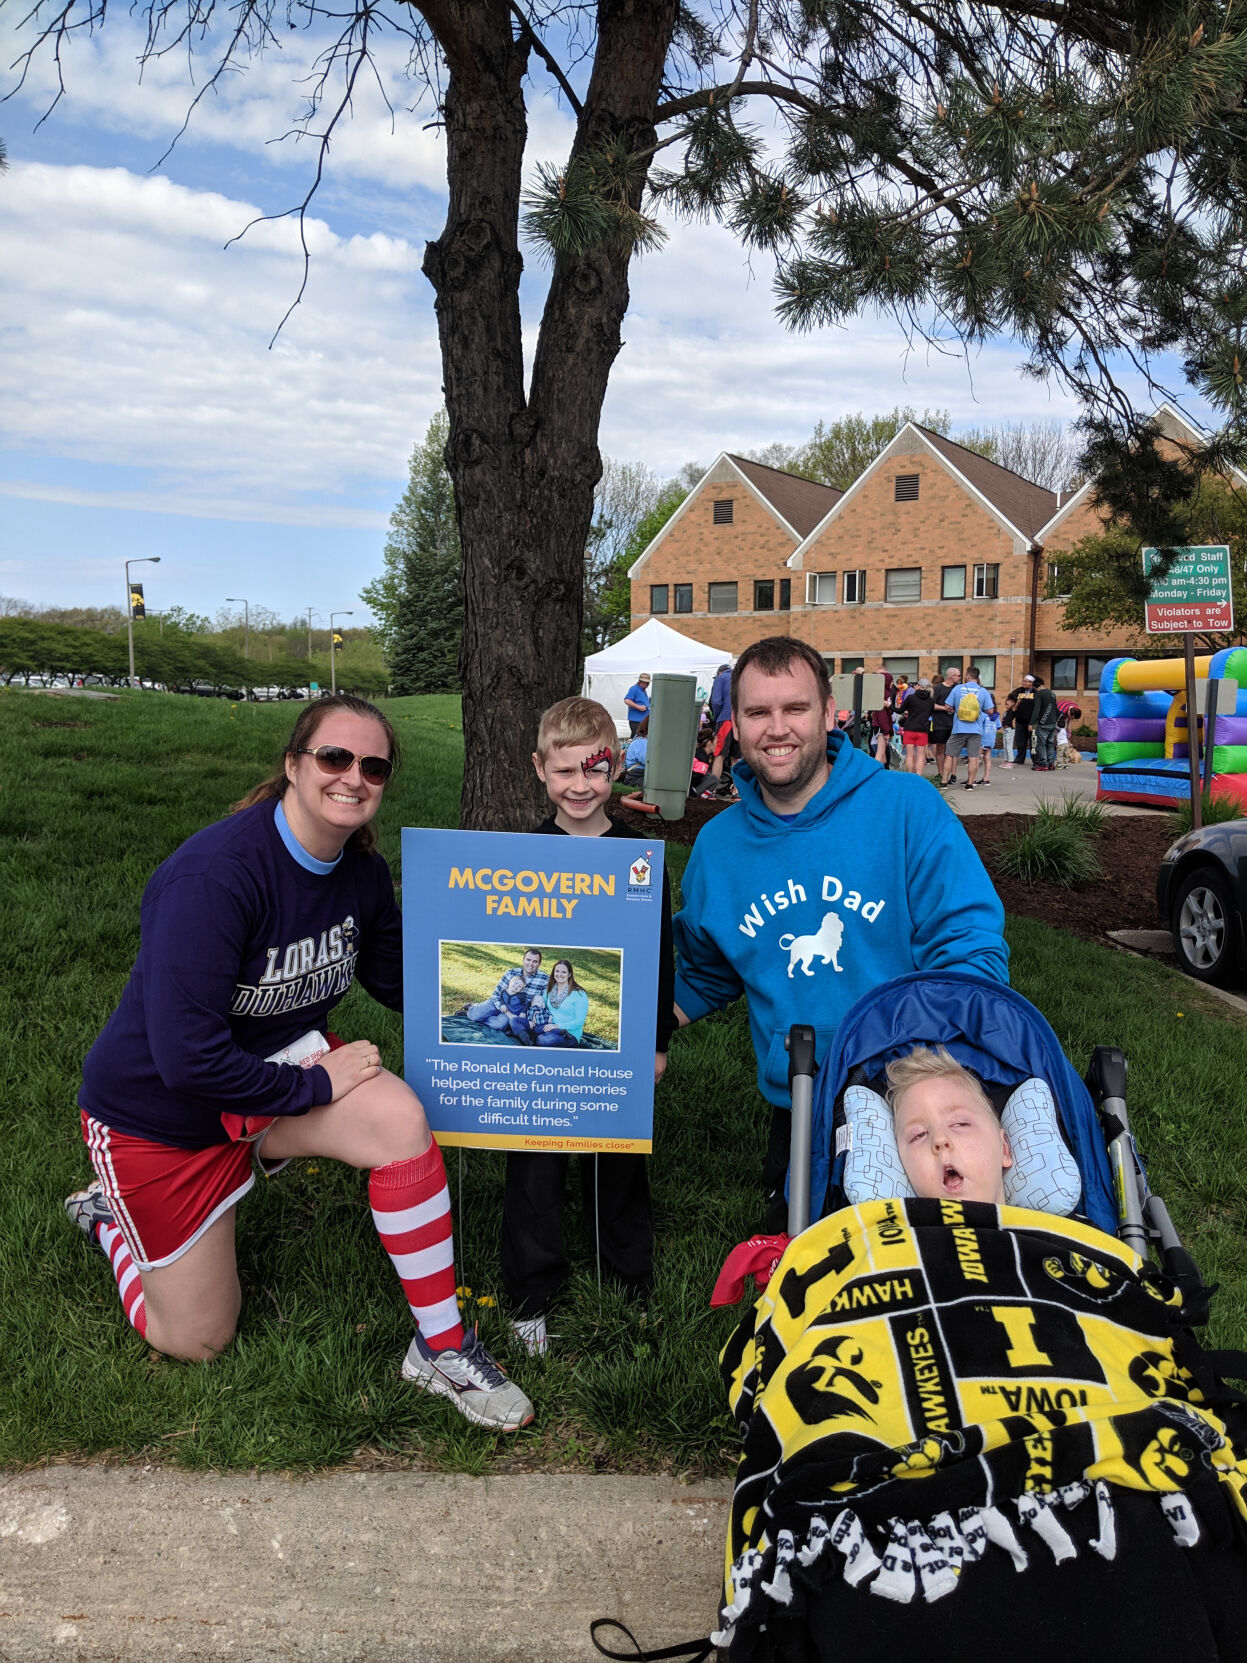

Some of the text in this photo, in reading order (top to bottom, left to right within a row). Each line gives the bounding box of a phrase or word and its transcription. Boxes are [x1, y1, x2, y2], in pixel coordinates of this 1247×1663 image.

[1200, 552, 1223, 561] Staff
[1196, 564, 1219, 574] Only
[1212, 577, 1227, 586] pm
[1150, 589, 1188, 599] Monday
[1196, 588, 1227, 597] Friday
[1156, 607, 1221, 617] Violators are
[1151, 619, 1229, 631] Subject to Tow
[448, 867, 616, 896] MCGOVERN
[486, 895, 579, 919] FAMILY
[738, 875, 886, 938] Wish Dad
[259, 924, 345, 985] LORAS
[461, 1060, 510, 1074] Ronald
[514, 1063, 585, 1077] McDonald
[588, 1066, 634, 1079] House
[431, 1076, 627, 1096] helped create fun memories
[439, 1093, 619, 1113] for the family during some
[478, 1111, 529, 1126] difficult
[524, 1138, 563, 1149] Keeping
[566, 1139, 603, 1149] families
[951, 1227, 989, 1284] IOWA
[999, 1385, 1087, 1412] IOWA
